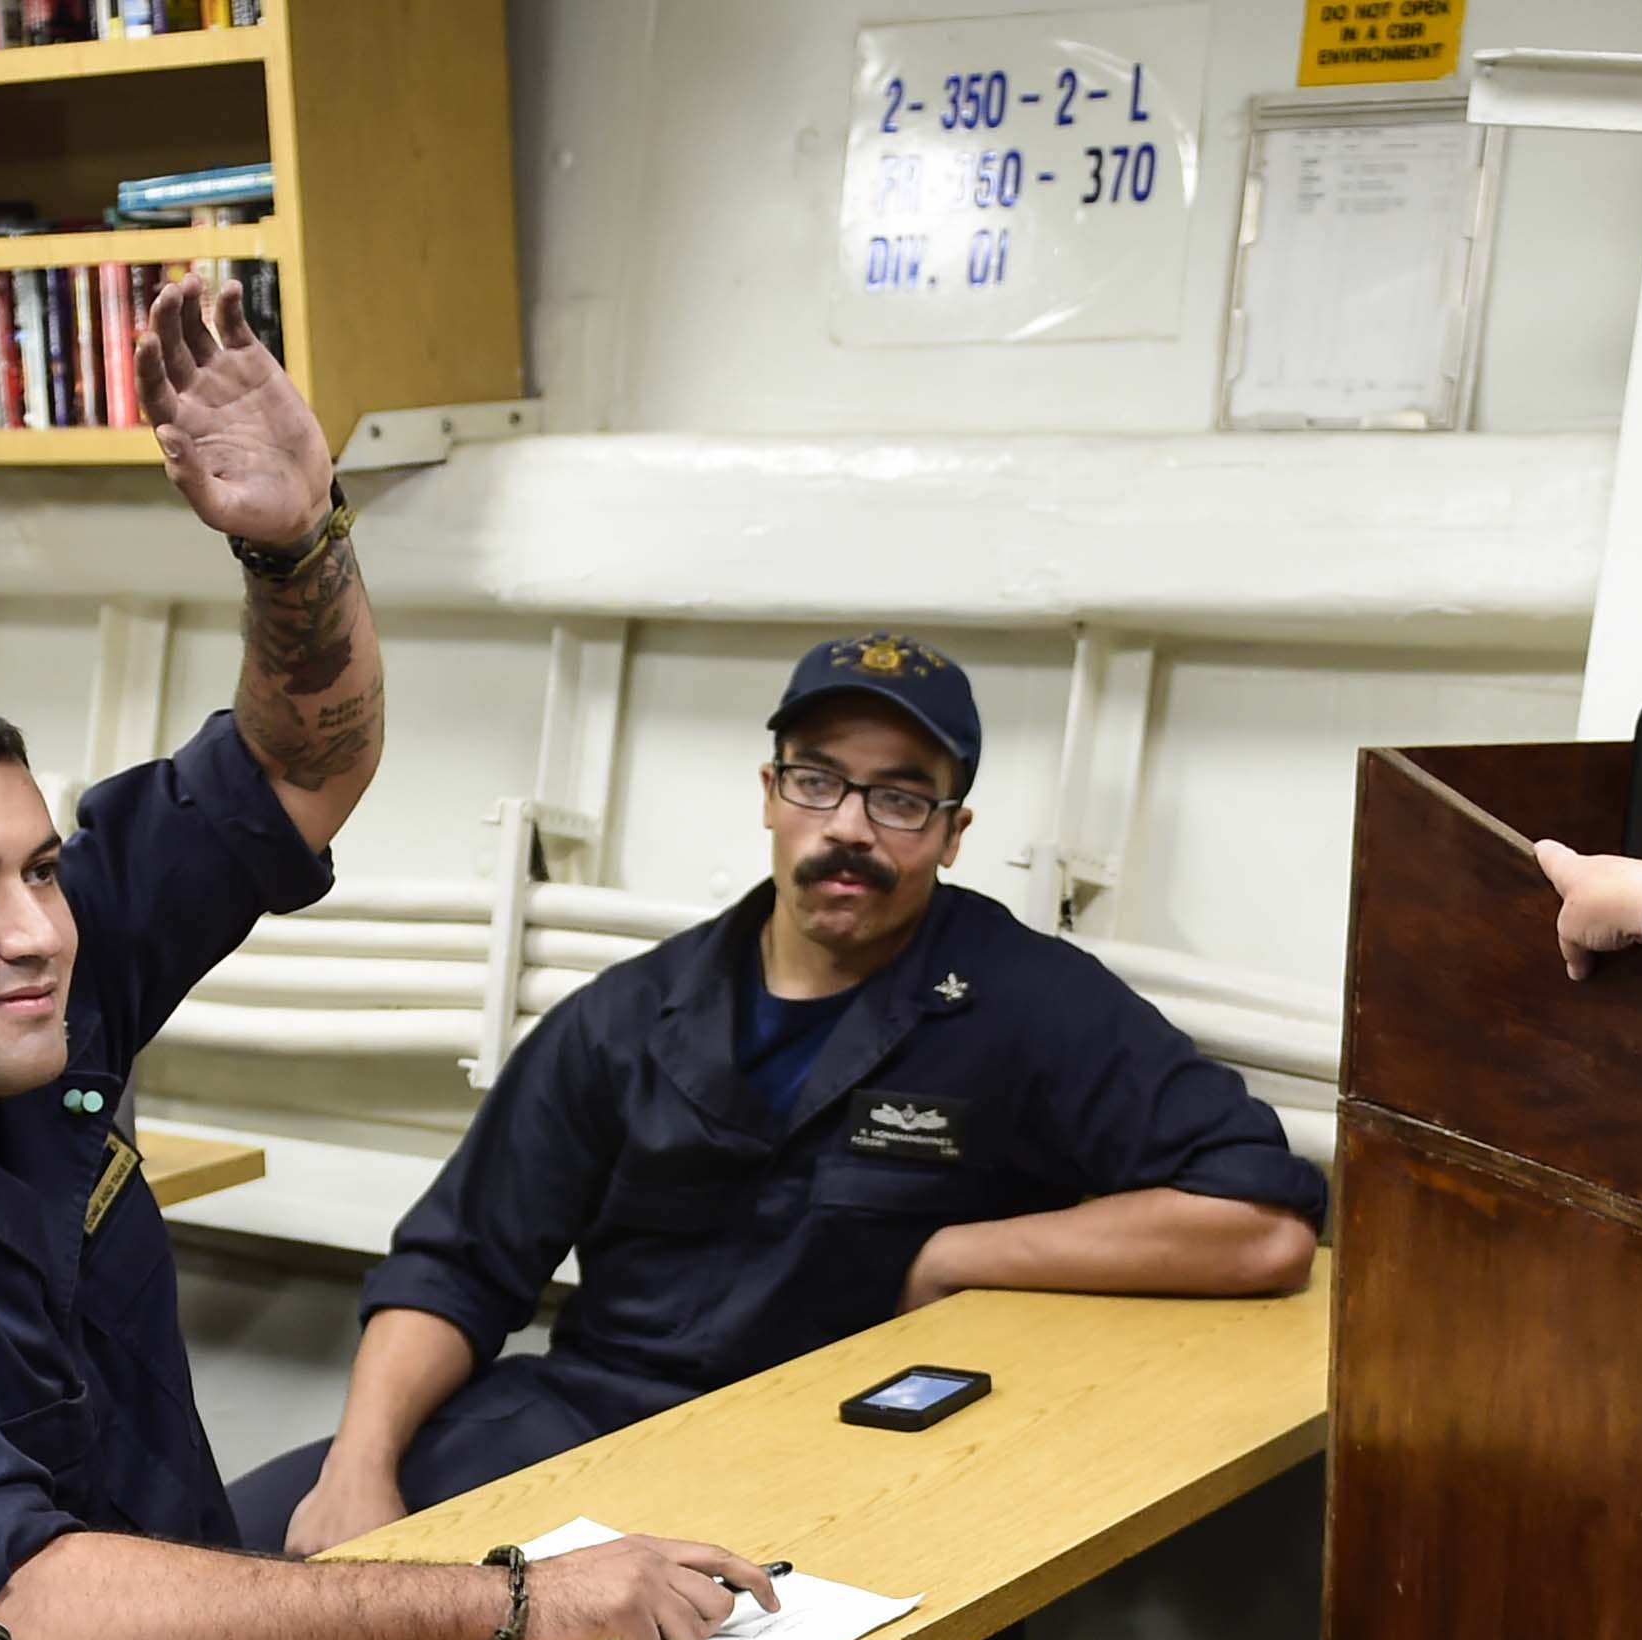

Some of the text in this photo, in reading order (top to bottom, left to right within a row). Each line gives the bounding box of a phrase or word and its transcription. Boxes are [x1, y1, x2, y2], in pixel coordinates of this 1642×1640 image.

[1320, 0, 1450, 22] DO NOT OPEN
[1341, 27, 1357, 42] IN
[1367, 26, 1379, 40] A
[1318, 42, 1443, 66] ENVIRONMENT
[1080, 142, 1157, 205] 370
